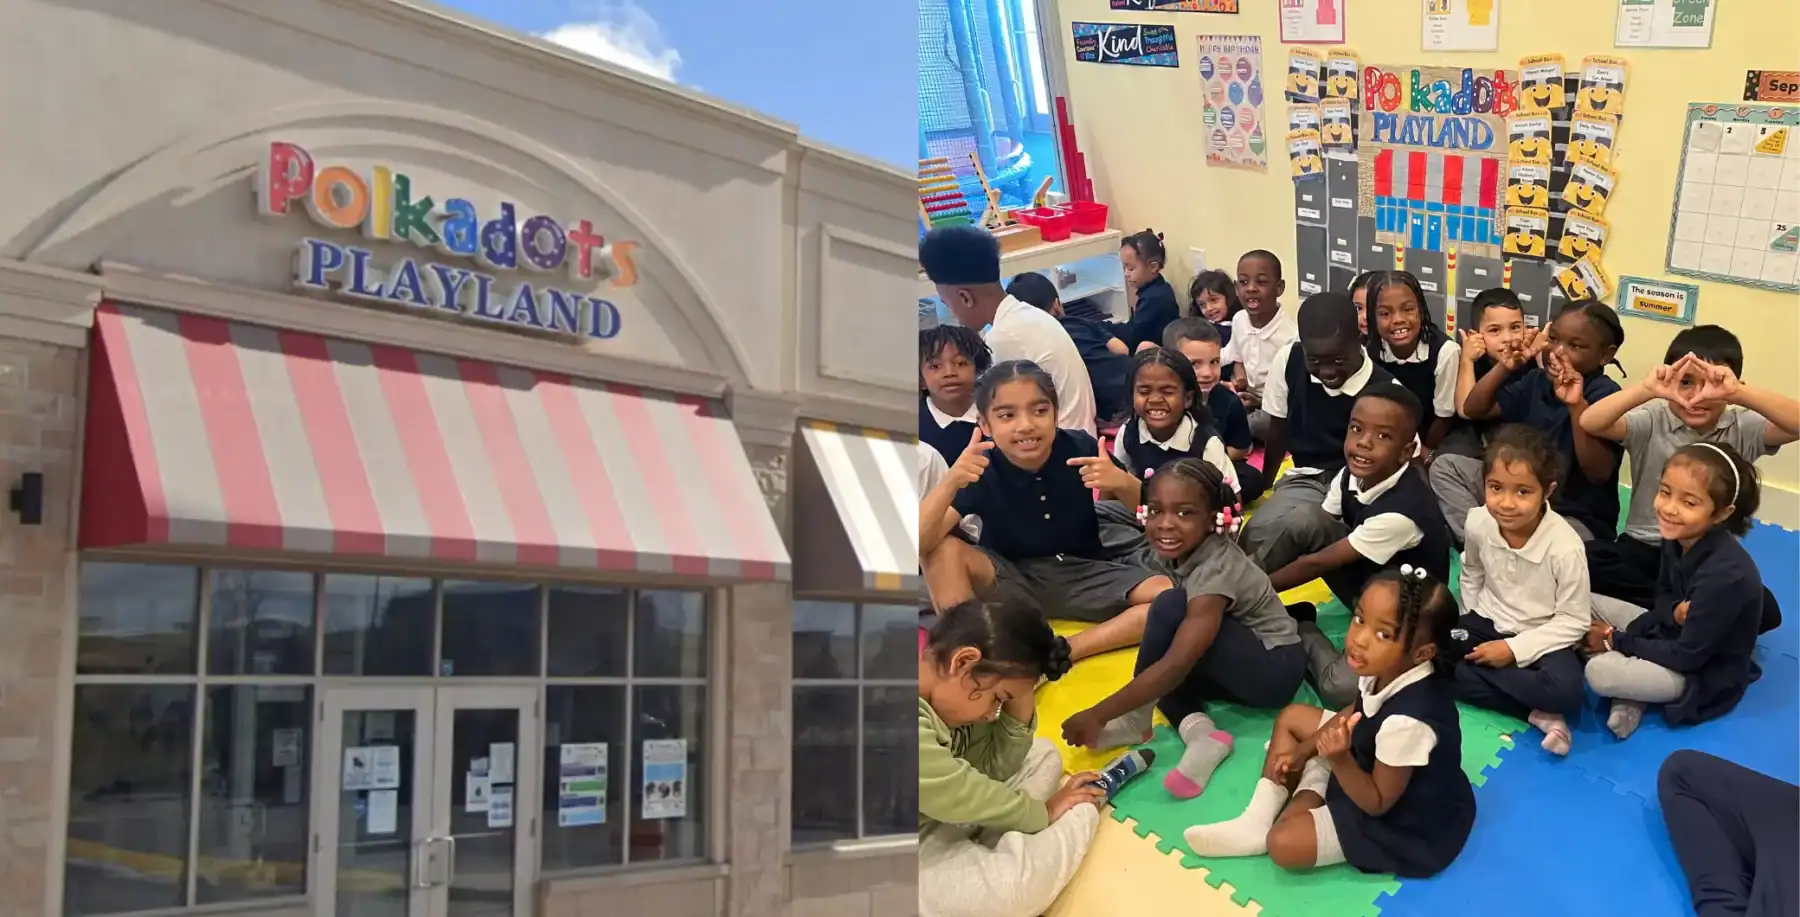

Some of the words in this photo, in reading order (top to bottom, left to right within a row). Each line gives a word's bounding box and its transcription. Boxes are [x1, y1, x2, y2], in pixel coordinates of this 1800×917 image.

[1674, 11, 1704, 24] Zone
[1098, 25, 1143, 61] Kind
[1364, 65, 1520, 118] Polkadots
[1769, 79, 1800, 95] Sep
[1370, 112, 1495, 151] PLAYLAND
[266, 141, 641, 288] Polkadots
[303, 238, 622, 339] PLAYLAND
[1631, 286, 1645, 295] The
[1646, 288, 1675, 299] season
[1676, 292, 1684, 300] is
[1639, 300, 1673, 312] summer
